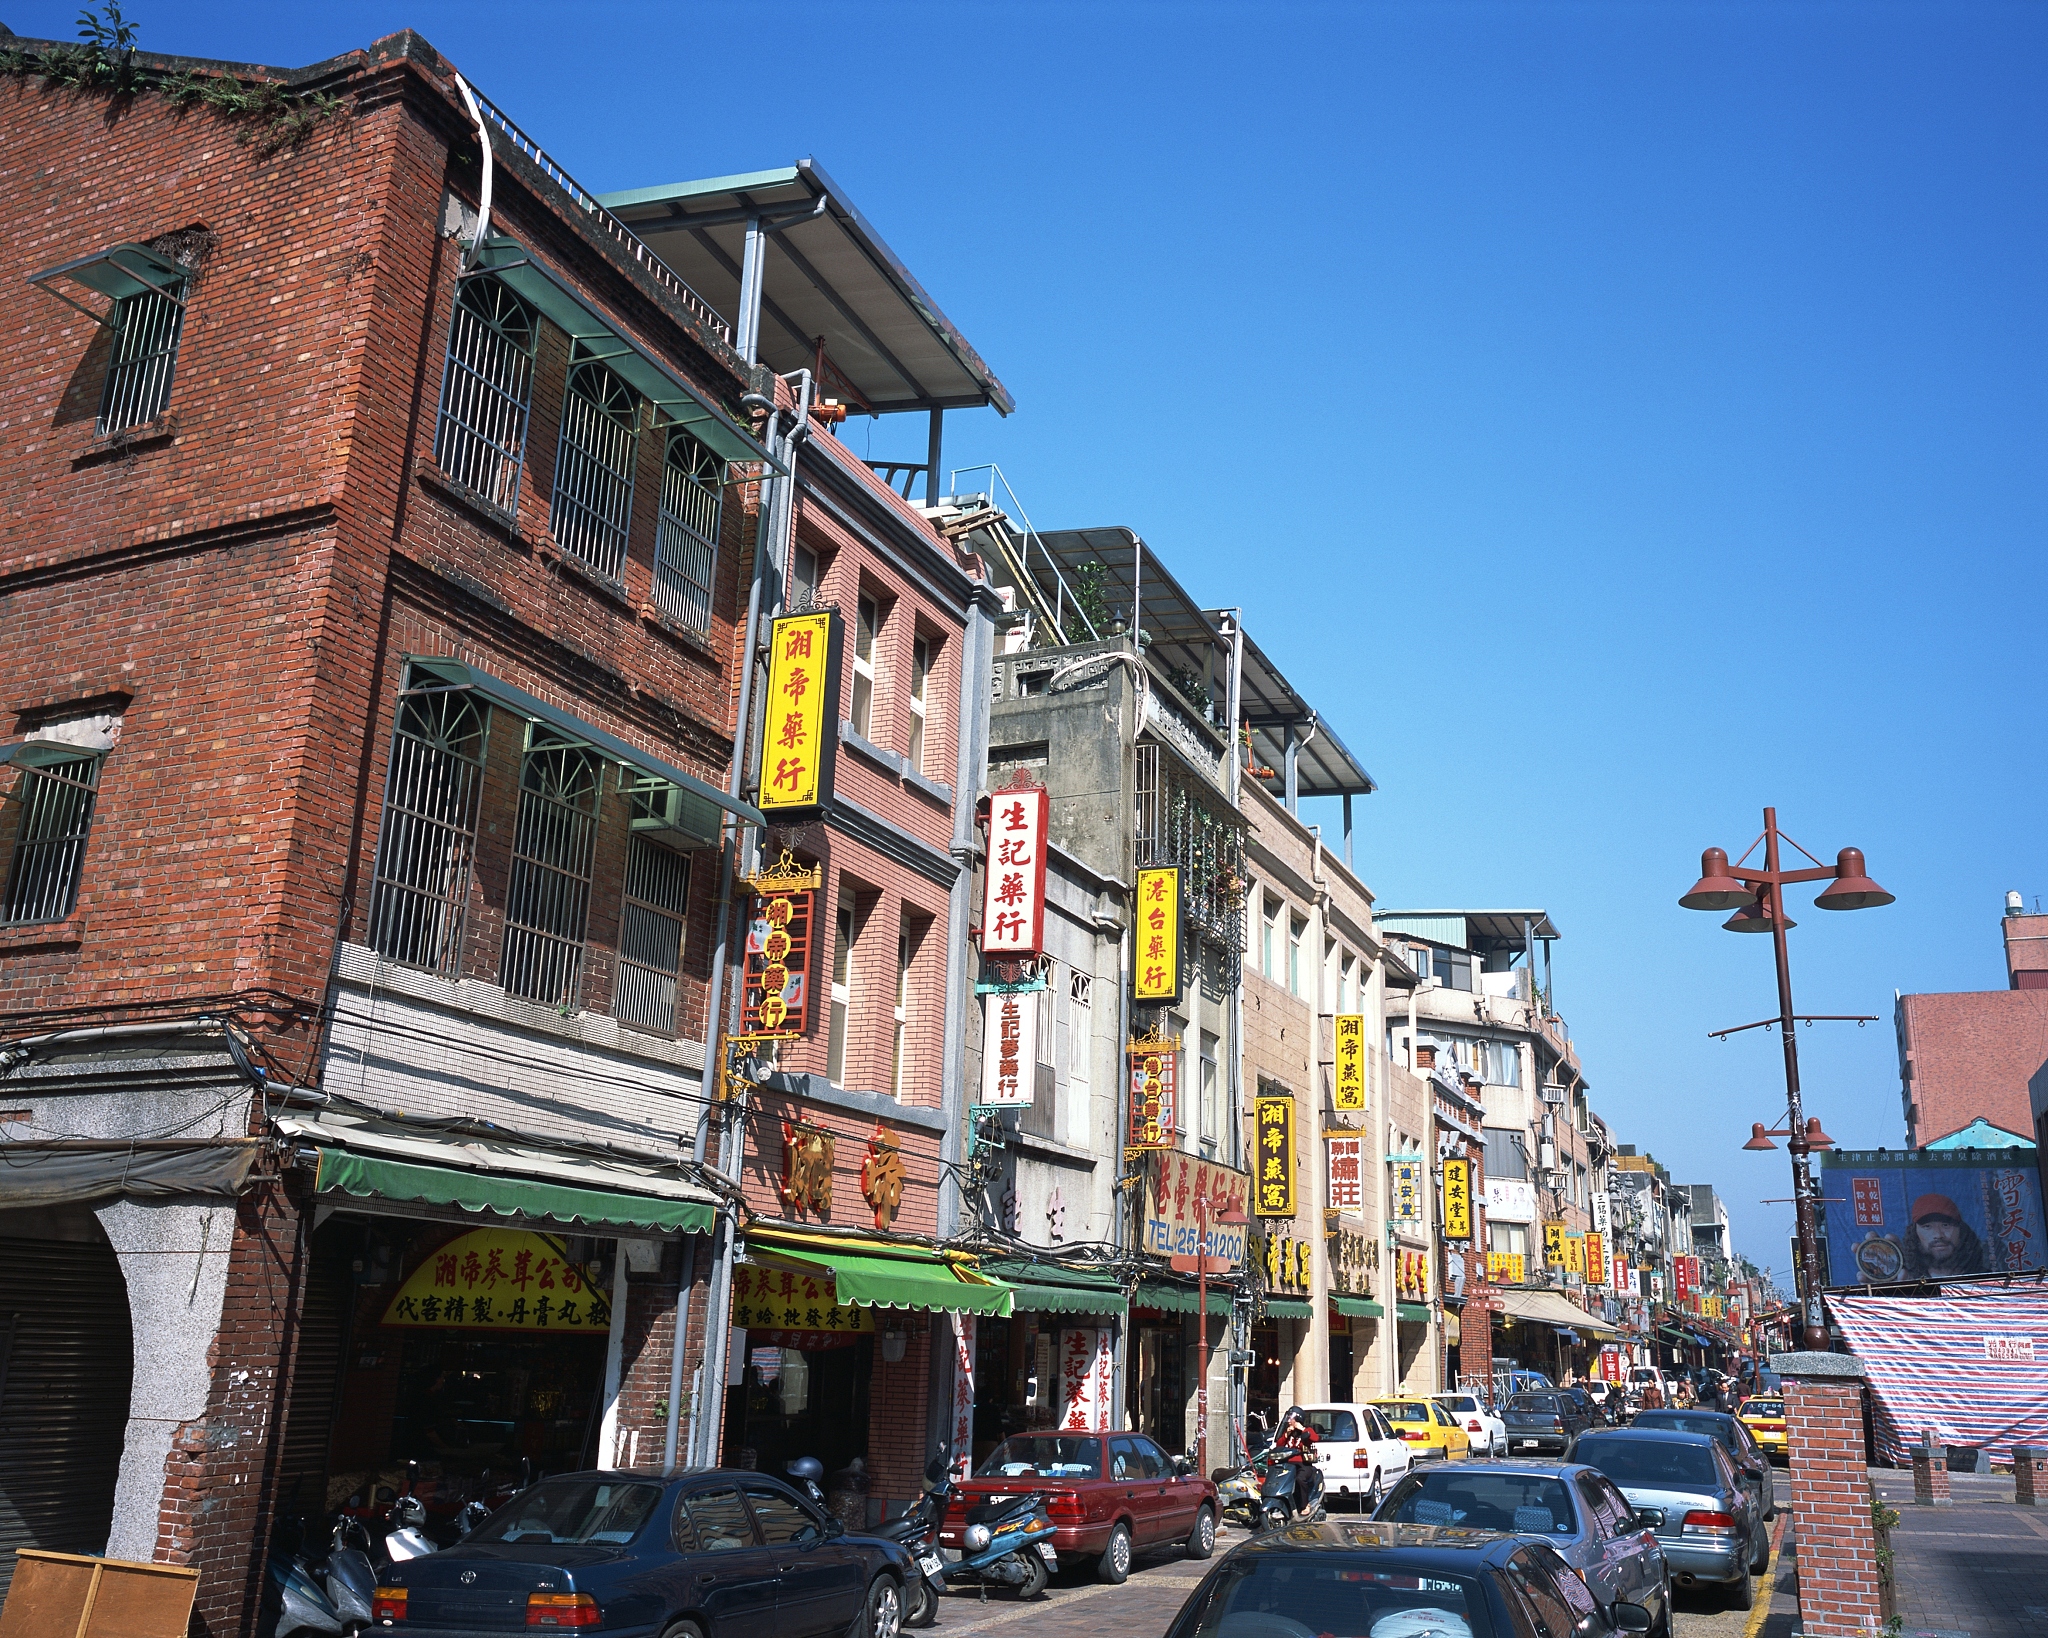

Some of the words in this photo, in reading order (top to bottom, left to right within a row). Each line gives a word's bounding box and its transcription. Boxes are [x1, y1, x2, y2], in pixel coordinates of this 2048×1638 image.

[772, 629, 814, 792] 湘帝藥行
[993, 801, 1031, 943] 生記藥行
[760, 901, 789, 1027] 湘帝藥行
[1143, 877, 1167, 989] 港台藥行
[1143, 1059, 1161, 1142] 港台藥行
[1340, 1019, 1359, 1106] 湘帝燕窩
[1261, 1103, 1286, 1208] 湘帝燕窩
[1448, 1165, 1466, 1219] 建安堂
[1993, 1169, 2034, 1271] 雪天果
